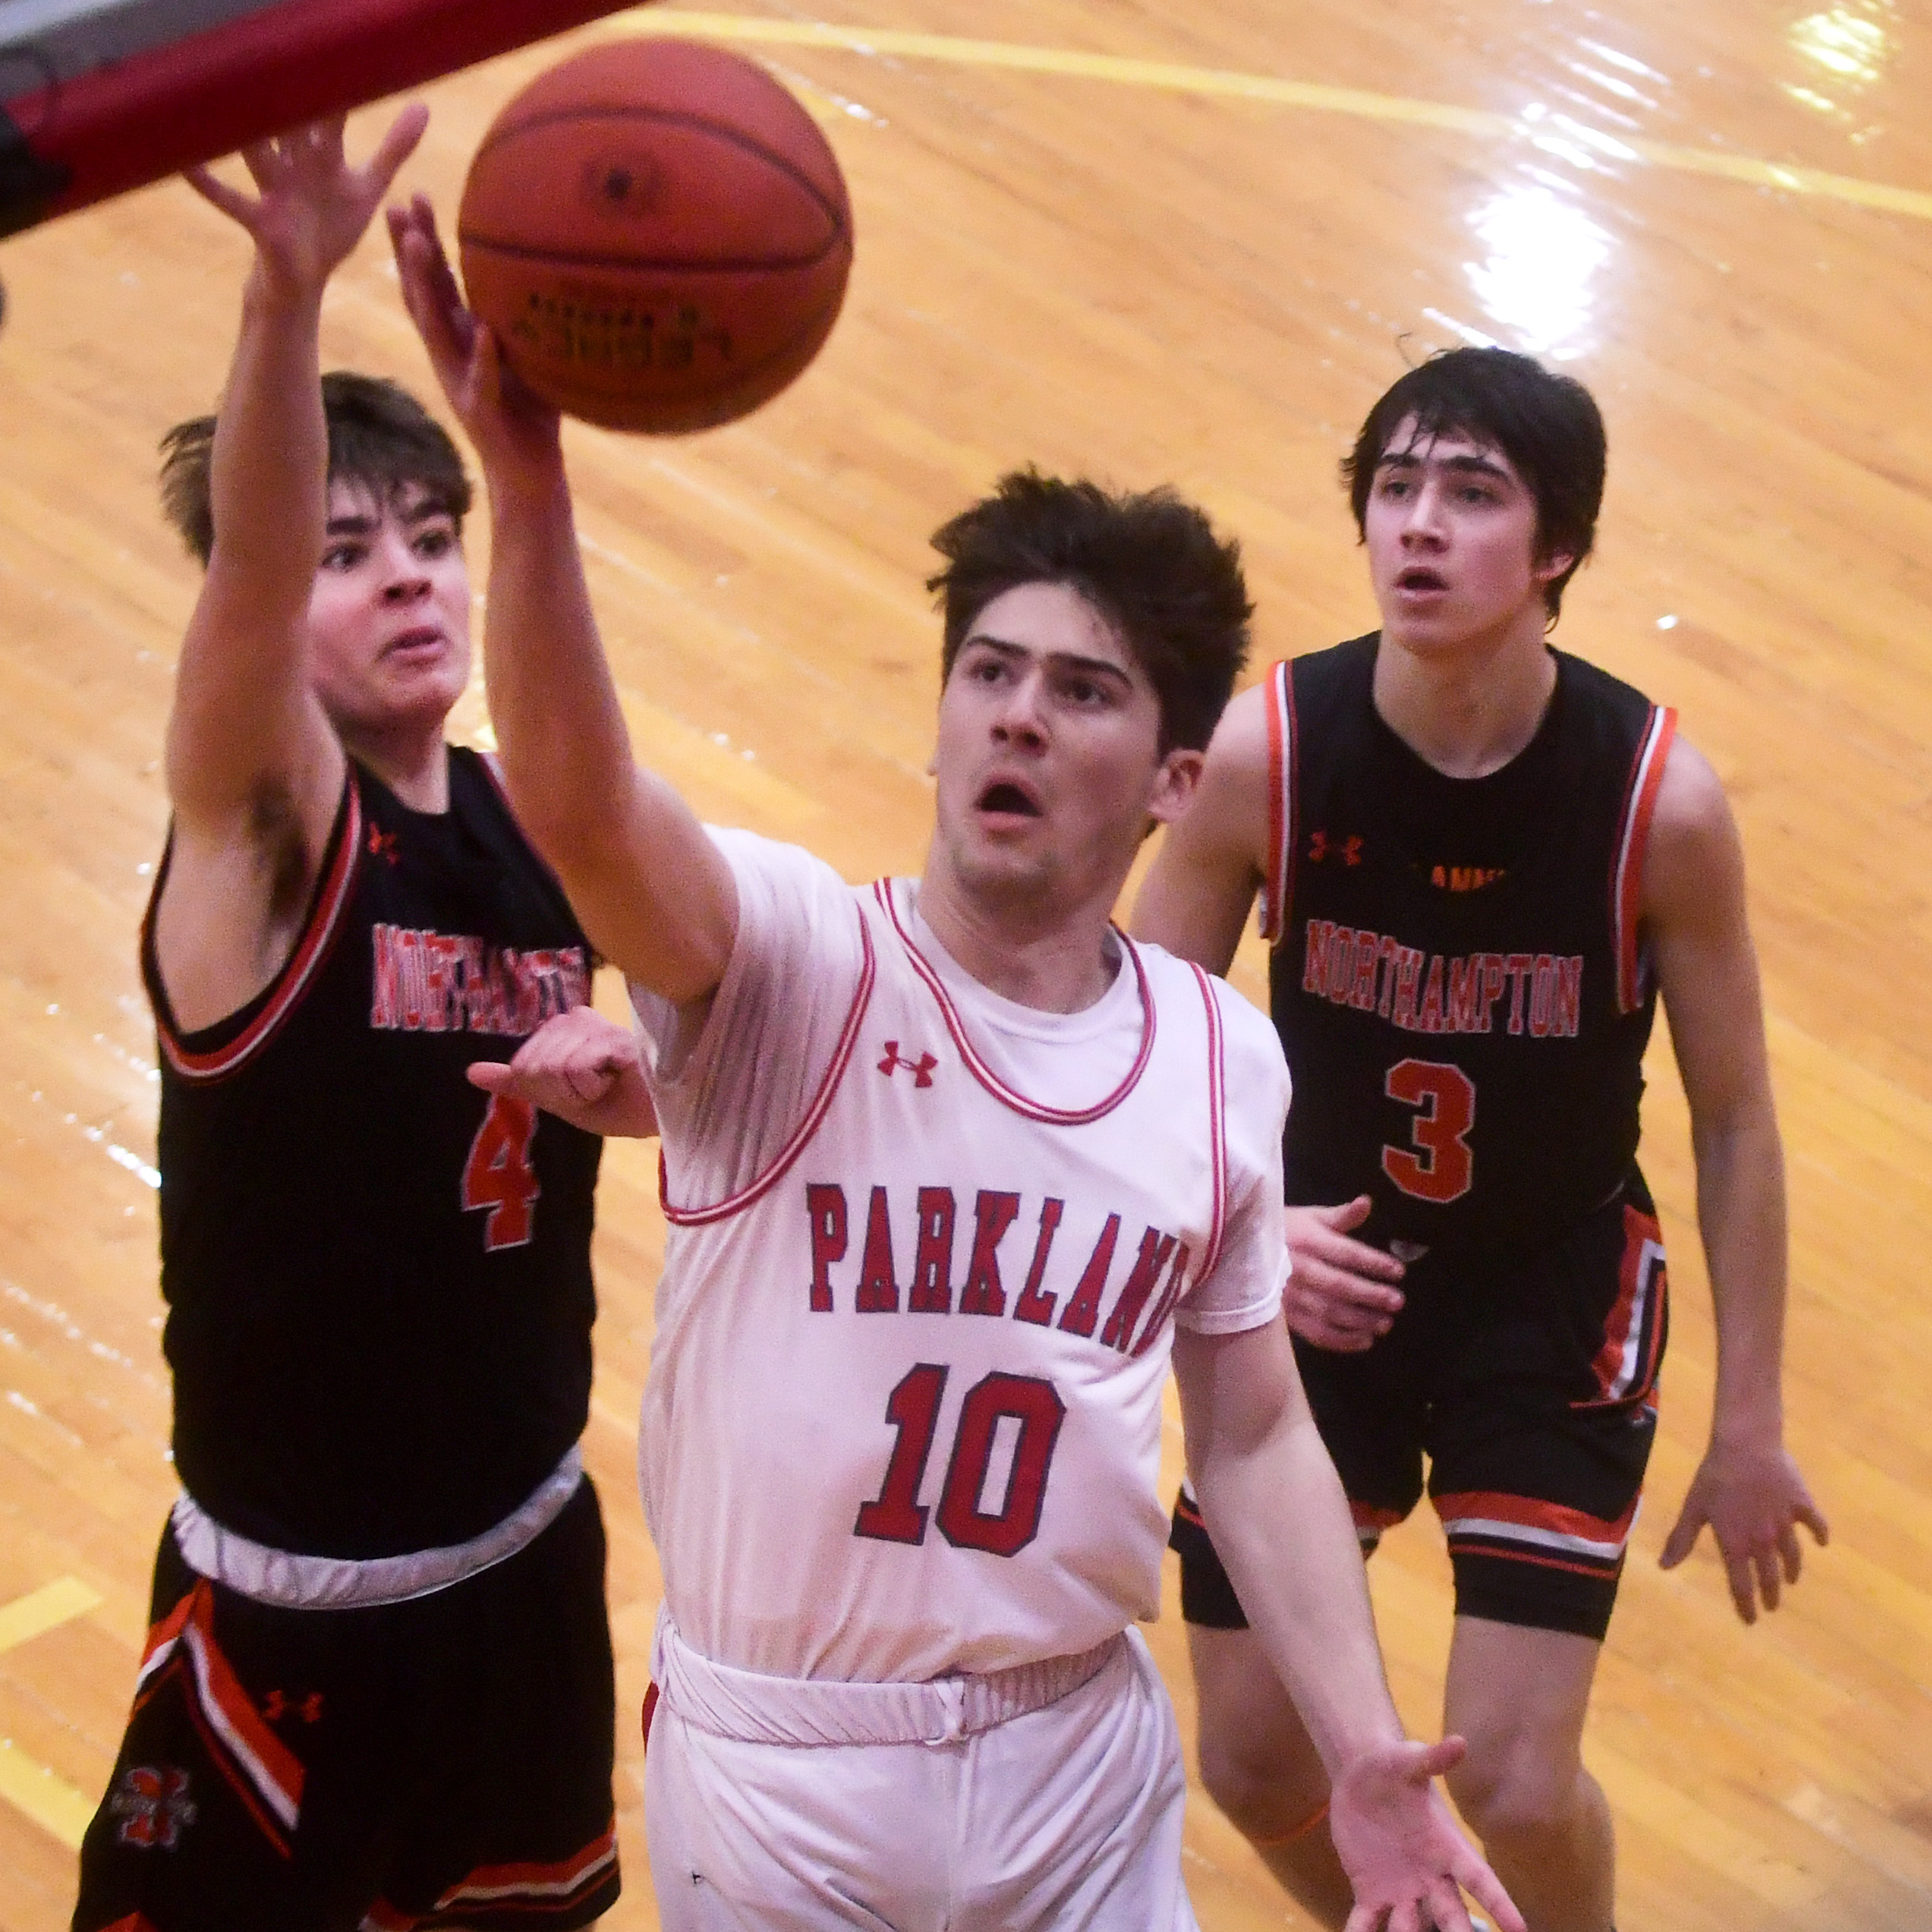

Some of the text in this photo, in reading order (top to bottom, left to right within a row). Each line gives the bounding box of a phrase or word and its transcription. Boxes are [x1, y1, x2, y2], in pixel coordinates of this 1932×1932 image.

[1302, 919, 1584, 1038] NORTHAMPTON
[461, 1094, 542, 1252] 4
[1381, 1057, 1476, 1203] 3
[853, 1362, 1067, 1558] 10
